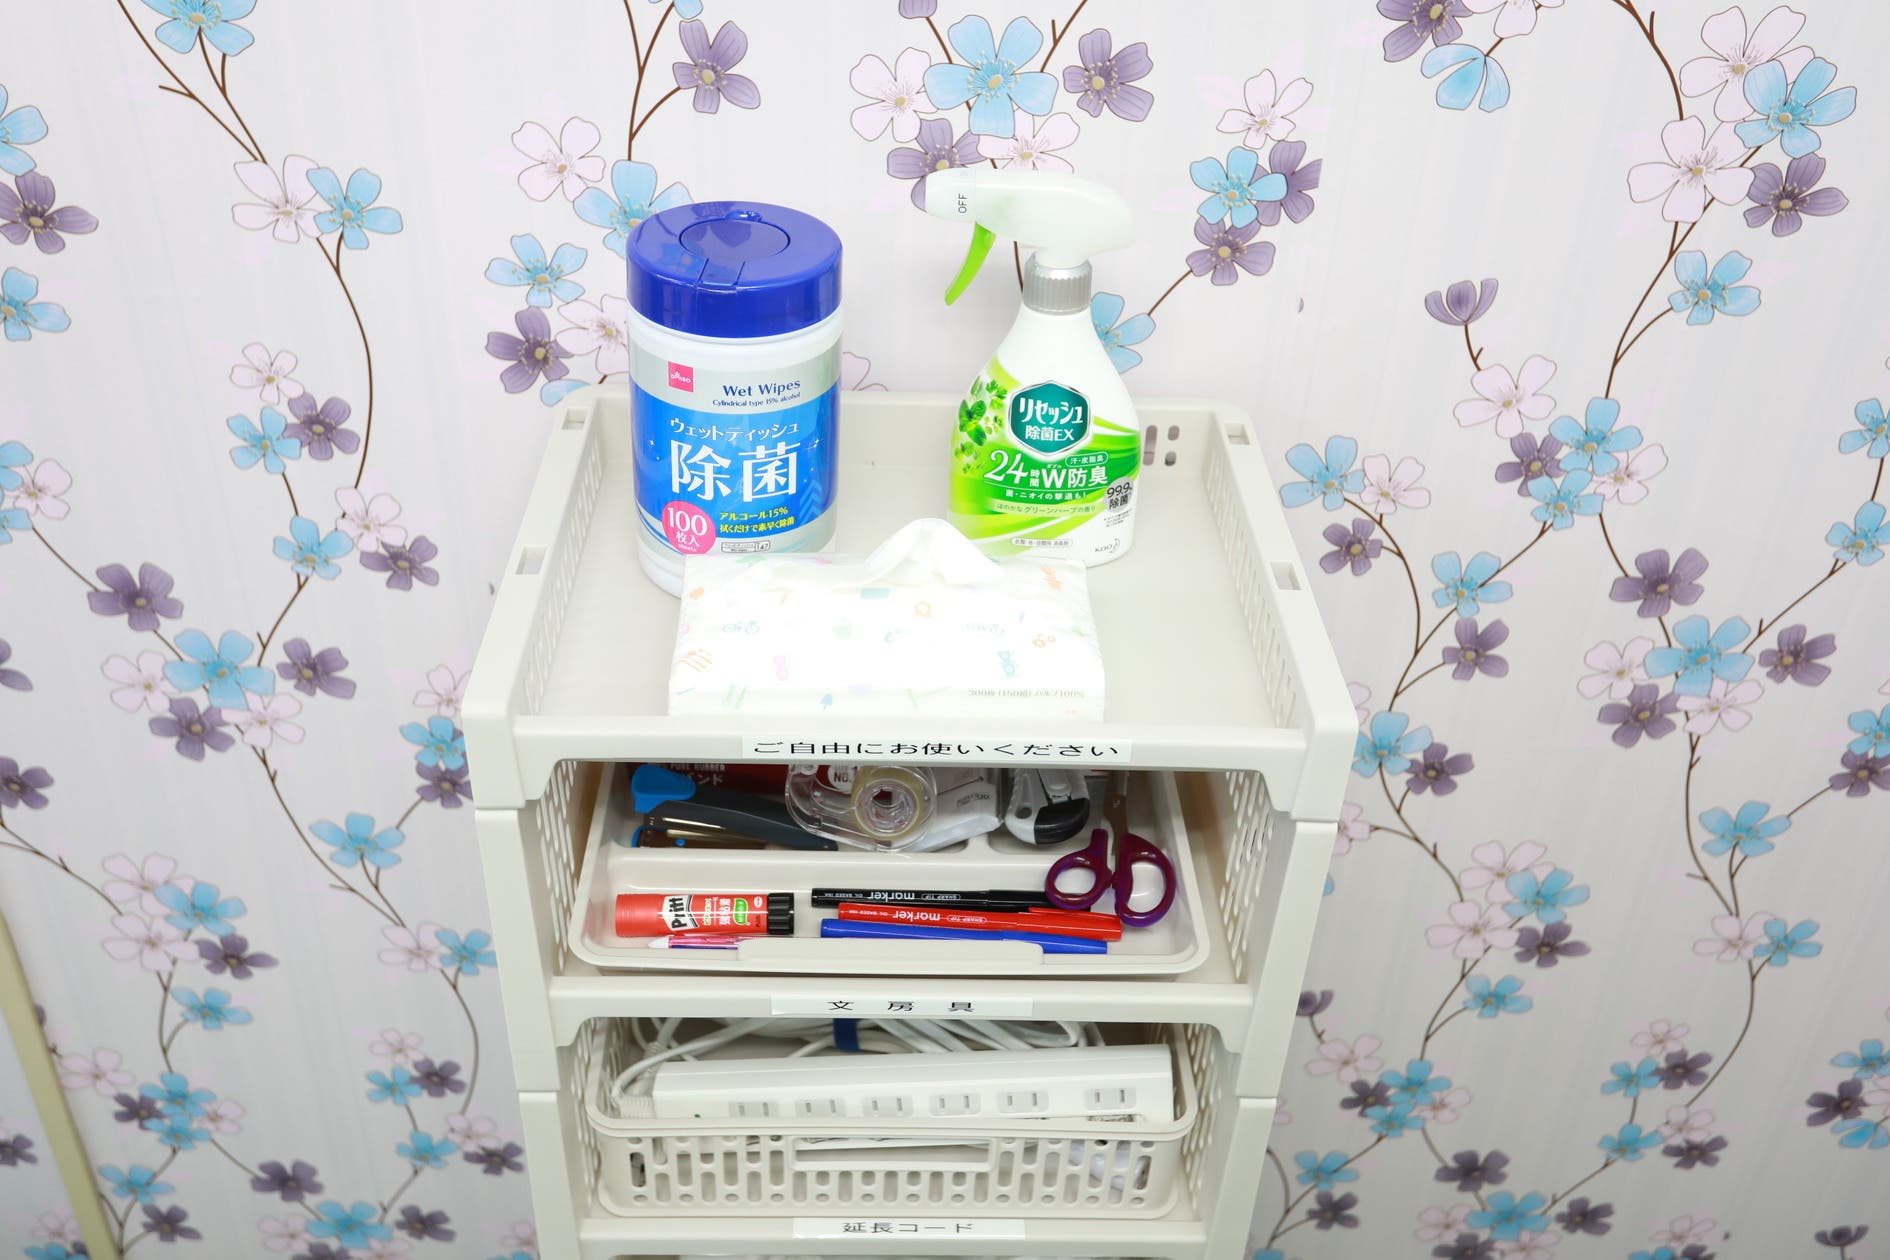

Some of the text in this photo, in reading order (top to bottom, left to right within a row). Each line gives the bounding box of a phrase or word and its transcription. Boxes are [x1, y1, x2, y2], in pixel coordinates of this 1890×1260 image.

[958, 193, 968, 214] OFF
[722, 380, 800, 397] Wet Wipes
[712, 399, 747, 407] Cylindrical
[749, 399, 763, 407] type
[780, 392, 801, 402] alcohol
[1019, 397, 1084, 425] リセッシュ
[670, 417, 799, 442] ウェットティッシュ
[1025, 425, 1075, 442] 除菌EX
[670, 439, 801, 503] 除菌
[1109, 494, 1129, 510] 除菌
[667, 507, 708, 536] 100
[719, 507, 789, 521] アルコール15%
[676, 531, 700, 548] 枚入
[754, 742, 1118, 757] ご自由にお使いください
[867, 890, 915, 903] marker
[669, 897, 687, 929] Pritt
[892, 910, 941, 924] marker
[842, 1222, 974, 1233] 延長コード
